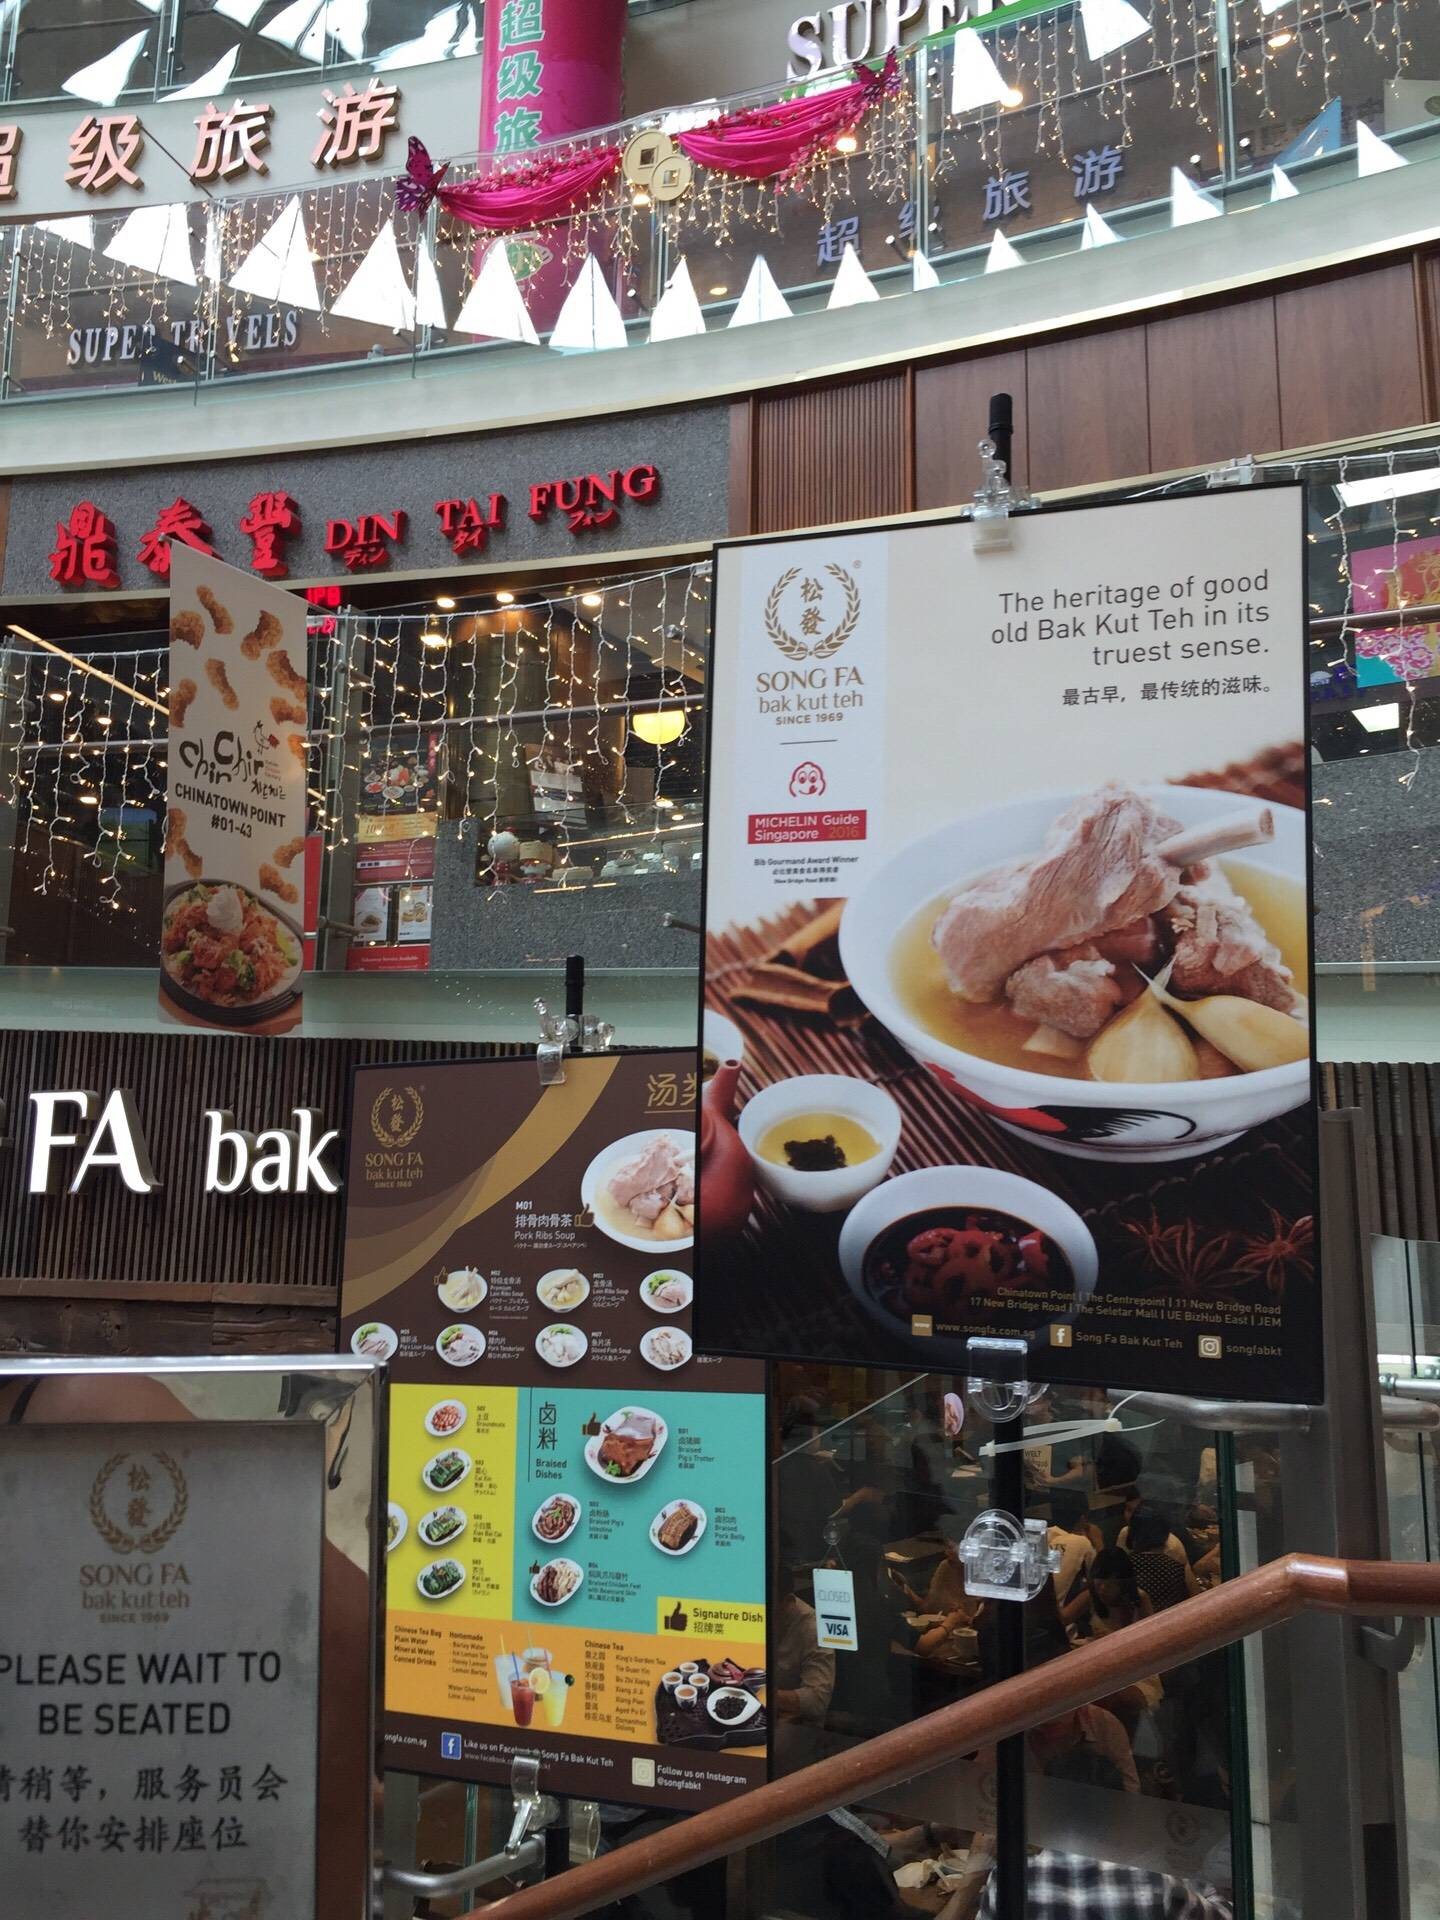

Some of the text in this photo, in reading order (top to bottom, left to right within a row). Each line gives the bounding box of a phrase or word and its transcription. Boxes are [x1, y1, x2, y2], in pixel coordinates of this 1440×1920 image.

[0, 79, 404, 202] 级旅游
[171, 310, 298, 354] TRVELS
[324, 464, 660, 553] DIN TAI FUNG
[999, 568, 1269, 614] The heritage of good
[800, 577, 826, 636] 松發
[991, 600, 1270, 644] old Bak Kut Teh in its
[1092, 637, 1270, 666] truest sense.
[756, 666, 864, 693] SONG FA
[759, 690, 863, 713] bak kut teh
[775, 712, 844, 726] SINCE 1969
[175, 782, 286, 828] CHINATOWN POINT
[211, 814, 252, 838] #01-43
[754, 813, 860, 829] MICHELIN Guide
[754, 828, 819, 843] Singapore
[767, 857, 806, 866] Gourmand
[807, 856, 831, 864] Award
[832, 855, 860, 863] Winner
[29, 1088, 341, 1195] FA bak
[365, 1151, 424, 1168] SONG FA
[366, 1167, 423, 1180] bak kut teh
[515, 1200, 533, 1210] M01
[514, 1230, 576, 1242] Pork Ribs Soup
[996, 1287, 1281, 1315] Chinatown Point The Centrepoint 11 New Bridge Road
[970, 1297, 1282, 1327] 17 New Bridge Road The Seletar Mall UE BizHub East JEM
[936, 1322, 1036, 1339] www.songfa.com.sg
[1076, 1331, 1183, 1349] Song Fa Bak Kut Teh
[1226, 1343, 1282, 1357] songfabkt
[537, 1400, 558, 1451] 卤料
[536, 1458, 567, 1469] Braised
[536, 1469, 562, 1480] Dishes
[80, 1562, 192, 1587] SONG FA
[82, 1588, 190, 1610] bak kut teh
[817, 1589, 850, 1603] CLOSED
[99, 1613, 137, 1624] SINCE
[692, 1607, 763, 1623] Signature Dish
[394, 1625, 442, 1639] Chinese Tea Bag
[449, 1631, 484, 1642] Homemade
[693, 1621, 724, 1635] 招牌菜
[825, 1622, 849, 1636] VISA
[394, 1635, 428, 1645] Plain Water
[584, 1640, 624, 1651] Chinese Tea
[394, 1645, 435, 1656] Mineral Water
[0, 1651, 281, 1685] PLEASE WAIT TO
[393, 1655, 437, 1667] Canned Drinks
[38, 1702, 231, 1736] BE SEATED
[463, 1738, 478, 1748] Like
[479, 1742, 488, 1750] us
[489, 1743, 498, 1751] on
[541, 1749, 559, 1762] Song
[560, 1751, 569, 1762] Fa
[570, 1753, 585, 1764] Bak
[586, 1754, 599, 1766] Kut
[600, 1755, 614, 1768] Teh
[657, 1764, 747, 1785] Follow us on Instagram
[657, 1776, 702, 1791] @songfabkt
[18, 1813, 249, 1854] 替你安排座位
